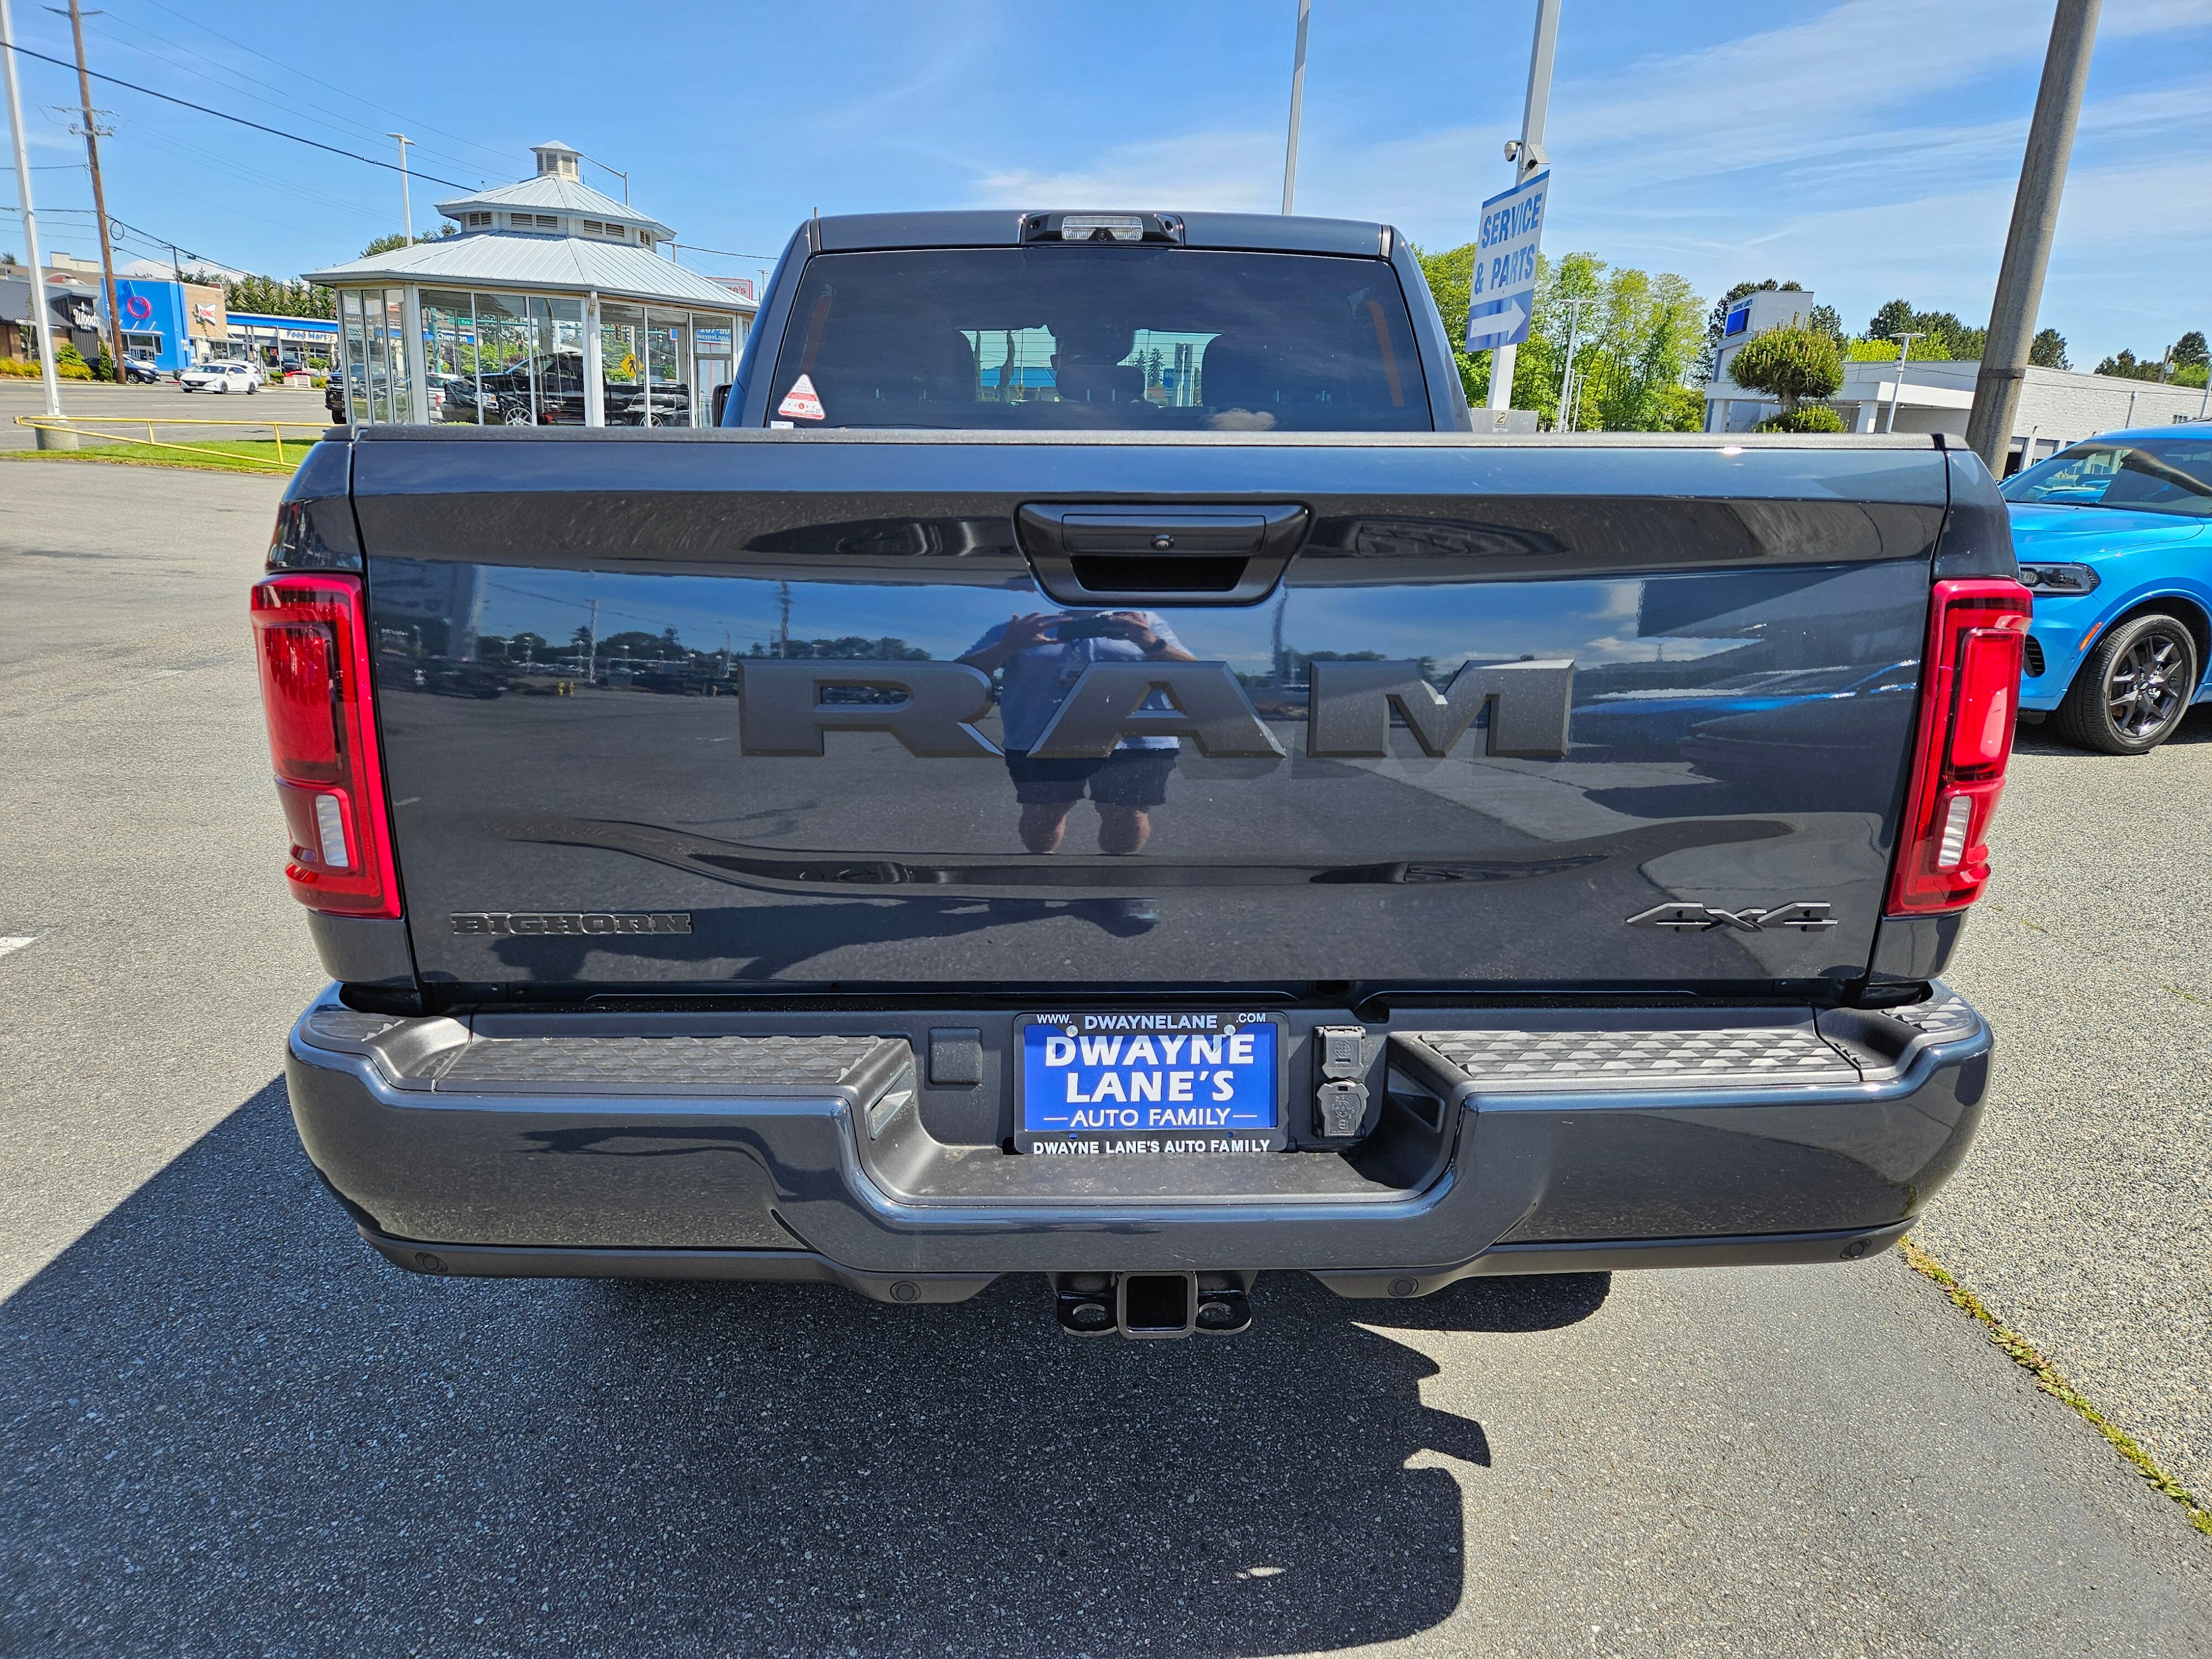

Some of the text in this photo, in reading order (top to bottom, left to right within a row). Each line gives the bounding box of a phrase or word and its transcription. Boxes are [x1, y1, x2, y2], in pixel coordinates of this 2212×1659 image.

[1482, 192, 1543, 249] SERVICE
[1474, 243, 1535, 295] & PARTS
[73, 308, 100, 327] Woods
[286, 330, 327, 341] Food Mart
[437, 332, 467, 342] Chevon
[1496, 412, 1506, 423] 2
[737, 659, 1576, 759] RAM
[450, 912, 693, 935] BIGHORN
[1084, 1015, 1217, 1030] DWAYNELANE
[1045, 1034, 1255, 1066] DWAYNE
[1067, 1070, 1234, 1103] LANE'S
[1070, 1108, 1231, 1127] AUTO FAMILY
[1033, 1139, 1270, 1154] DWAYNE LANE'S AUTO FAMILY
